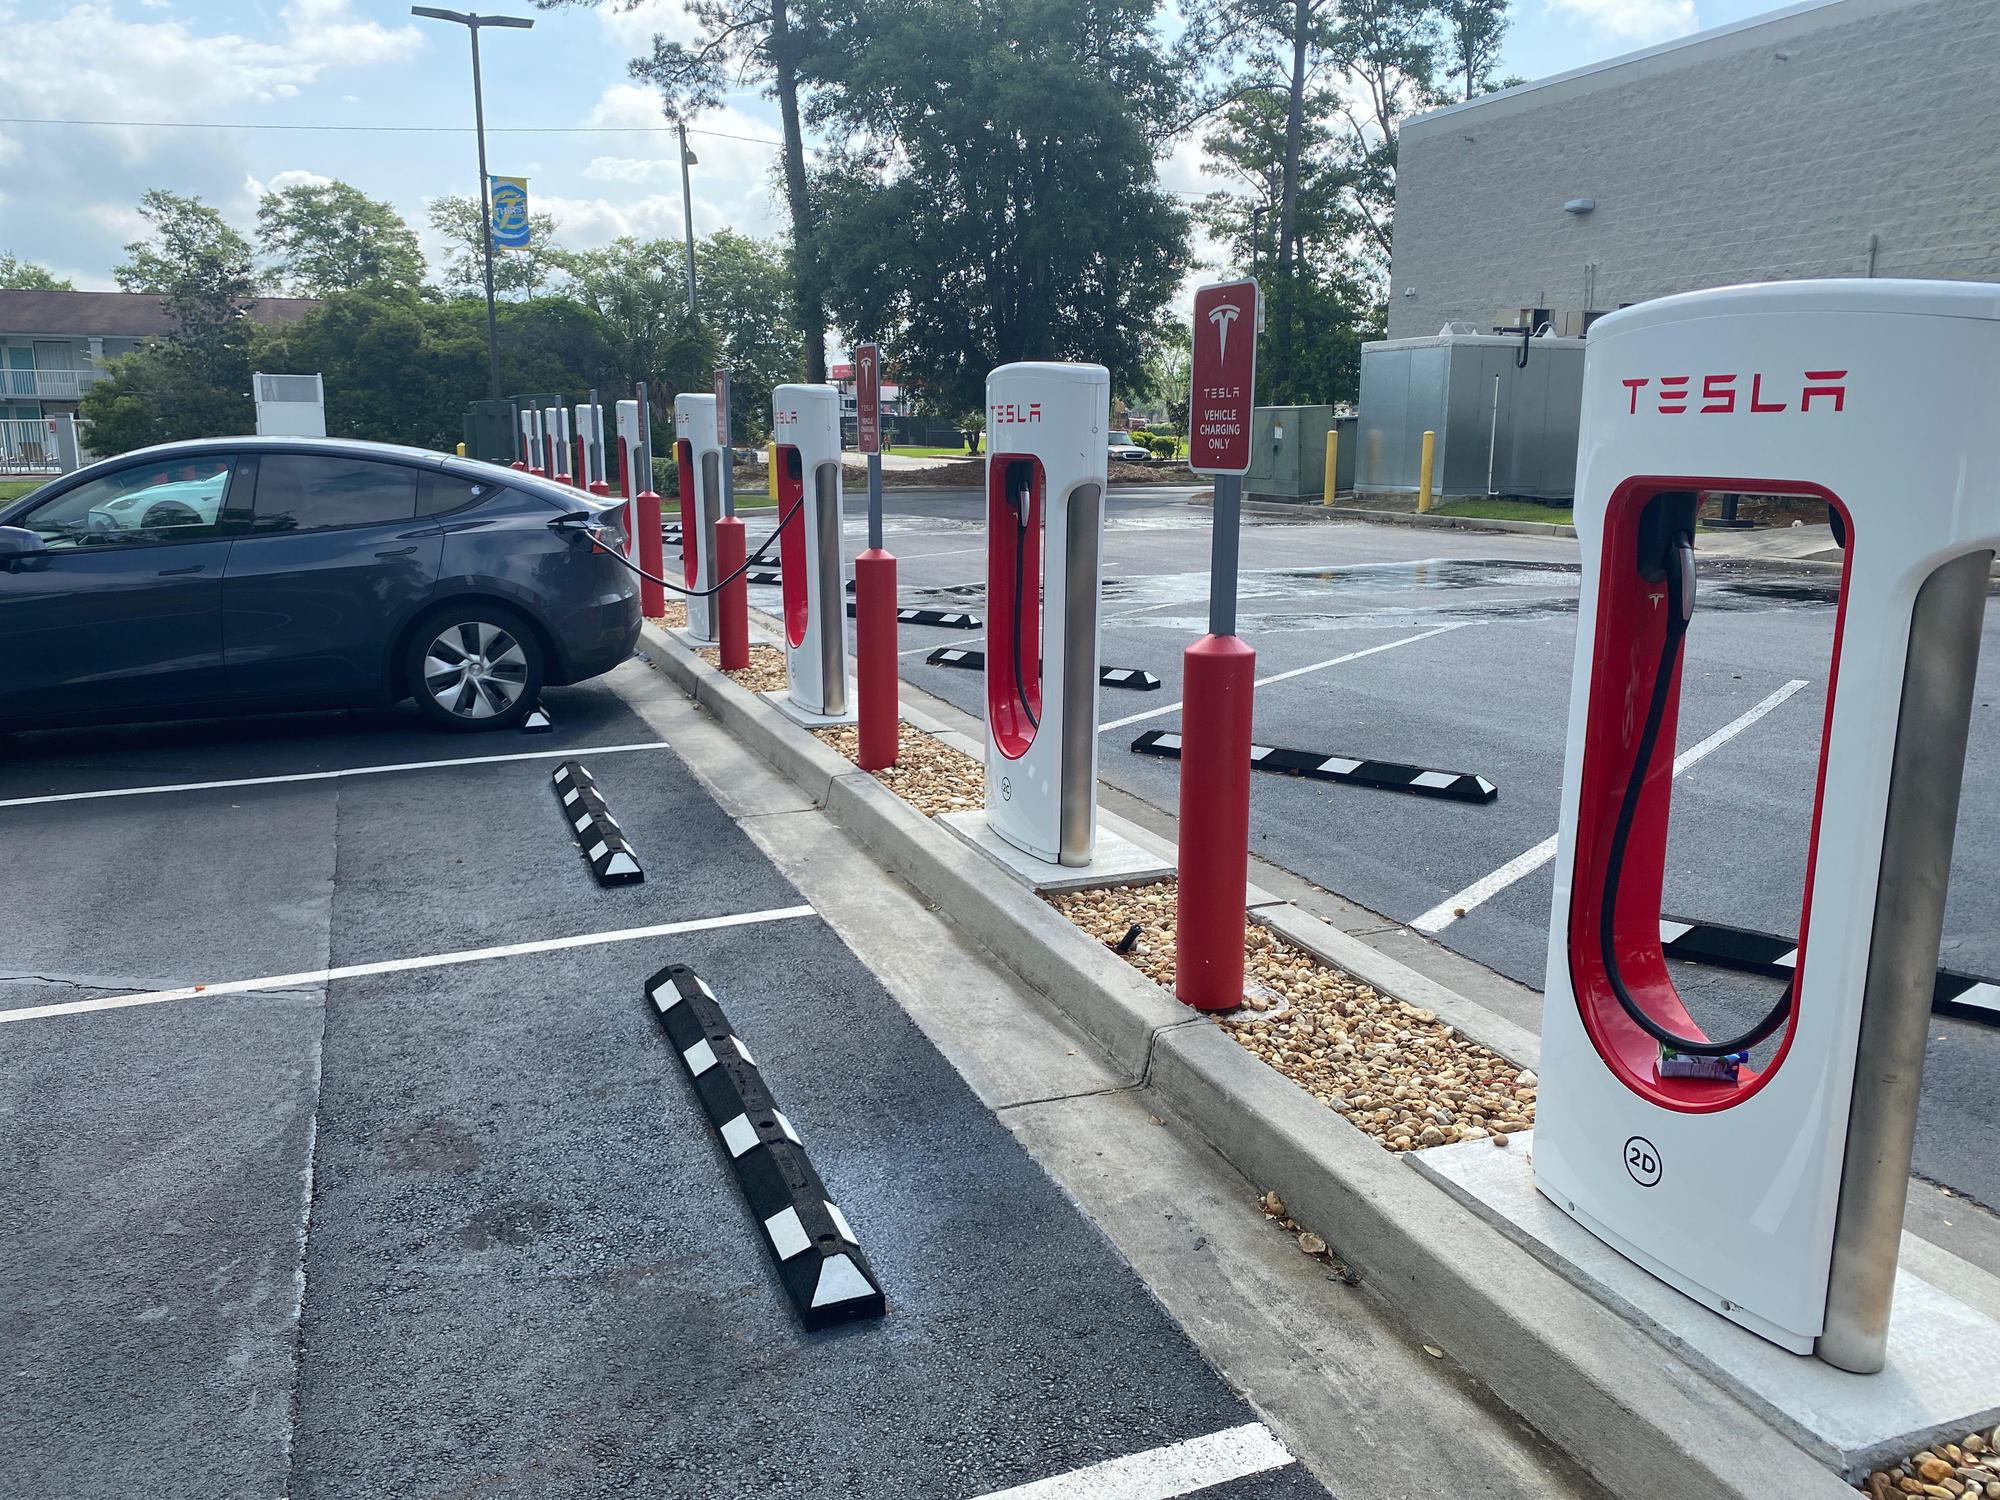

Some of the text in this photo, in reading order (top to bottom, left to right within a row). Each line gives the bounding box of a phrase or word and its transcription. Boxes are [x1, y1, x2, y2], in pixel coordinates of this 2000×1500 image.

[1204, 386, 1240, 398] TESLA
[1622, 370, 1848, 414] TESLA
[990, 403, 1041, 423] TESLA
[1204, 409, 1237, 421] VEHICLE
[1200, 423, 1241, 435] CHARGING
[1208, 438, 1230, 449] ONLY
[1629, 1147, 1656, 1174] 2D
